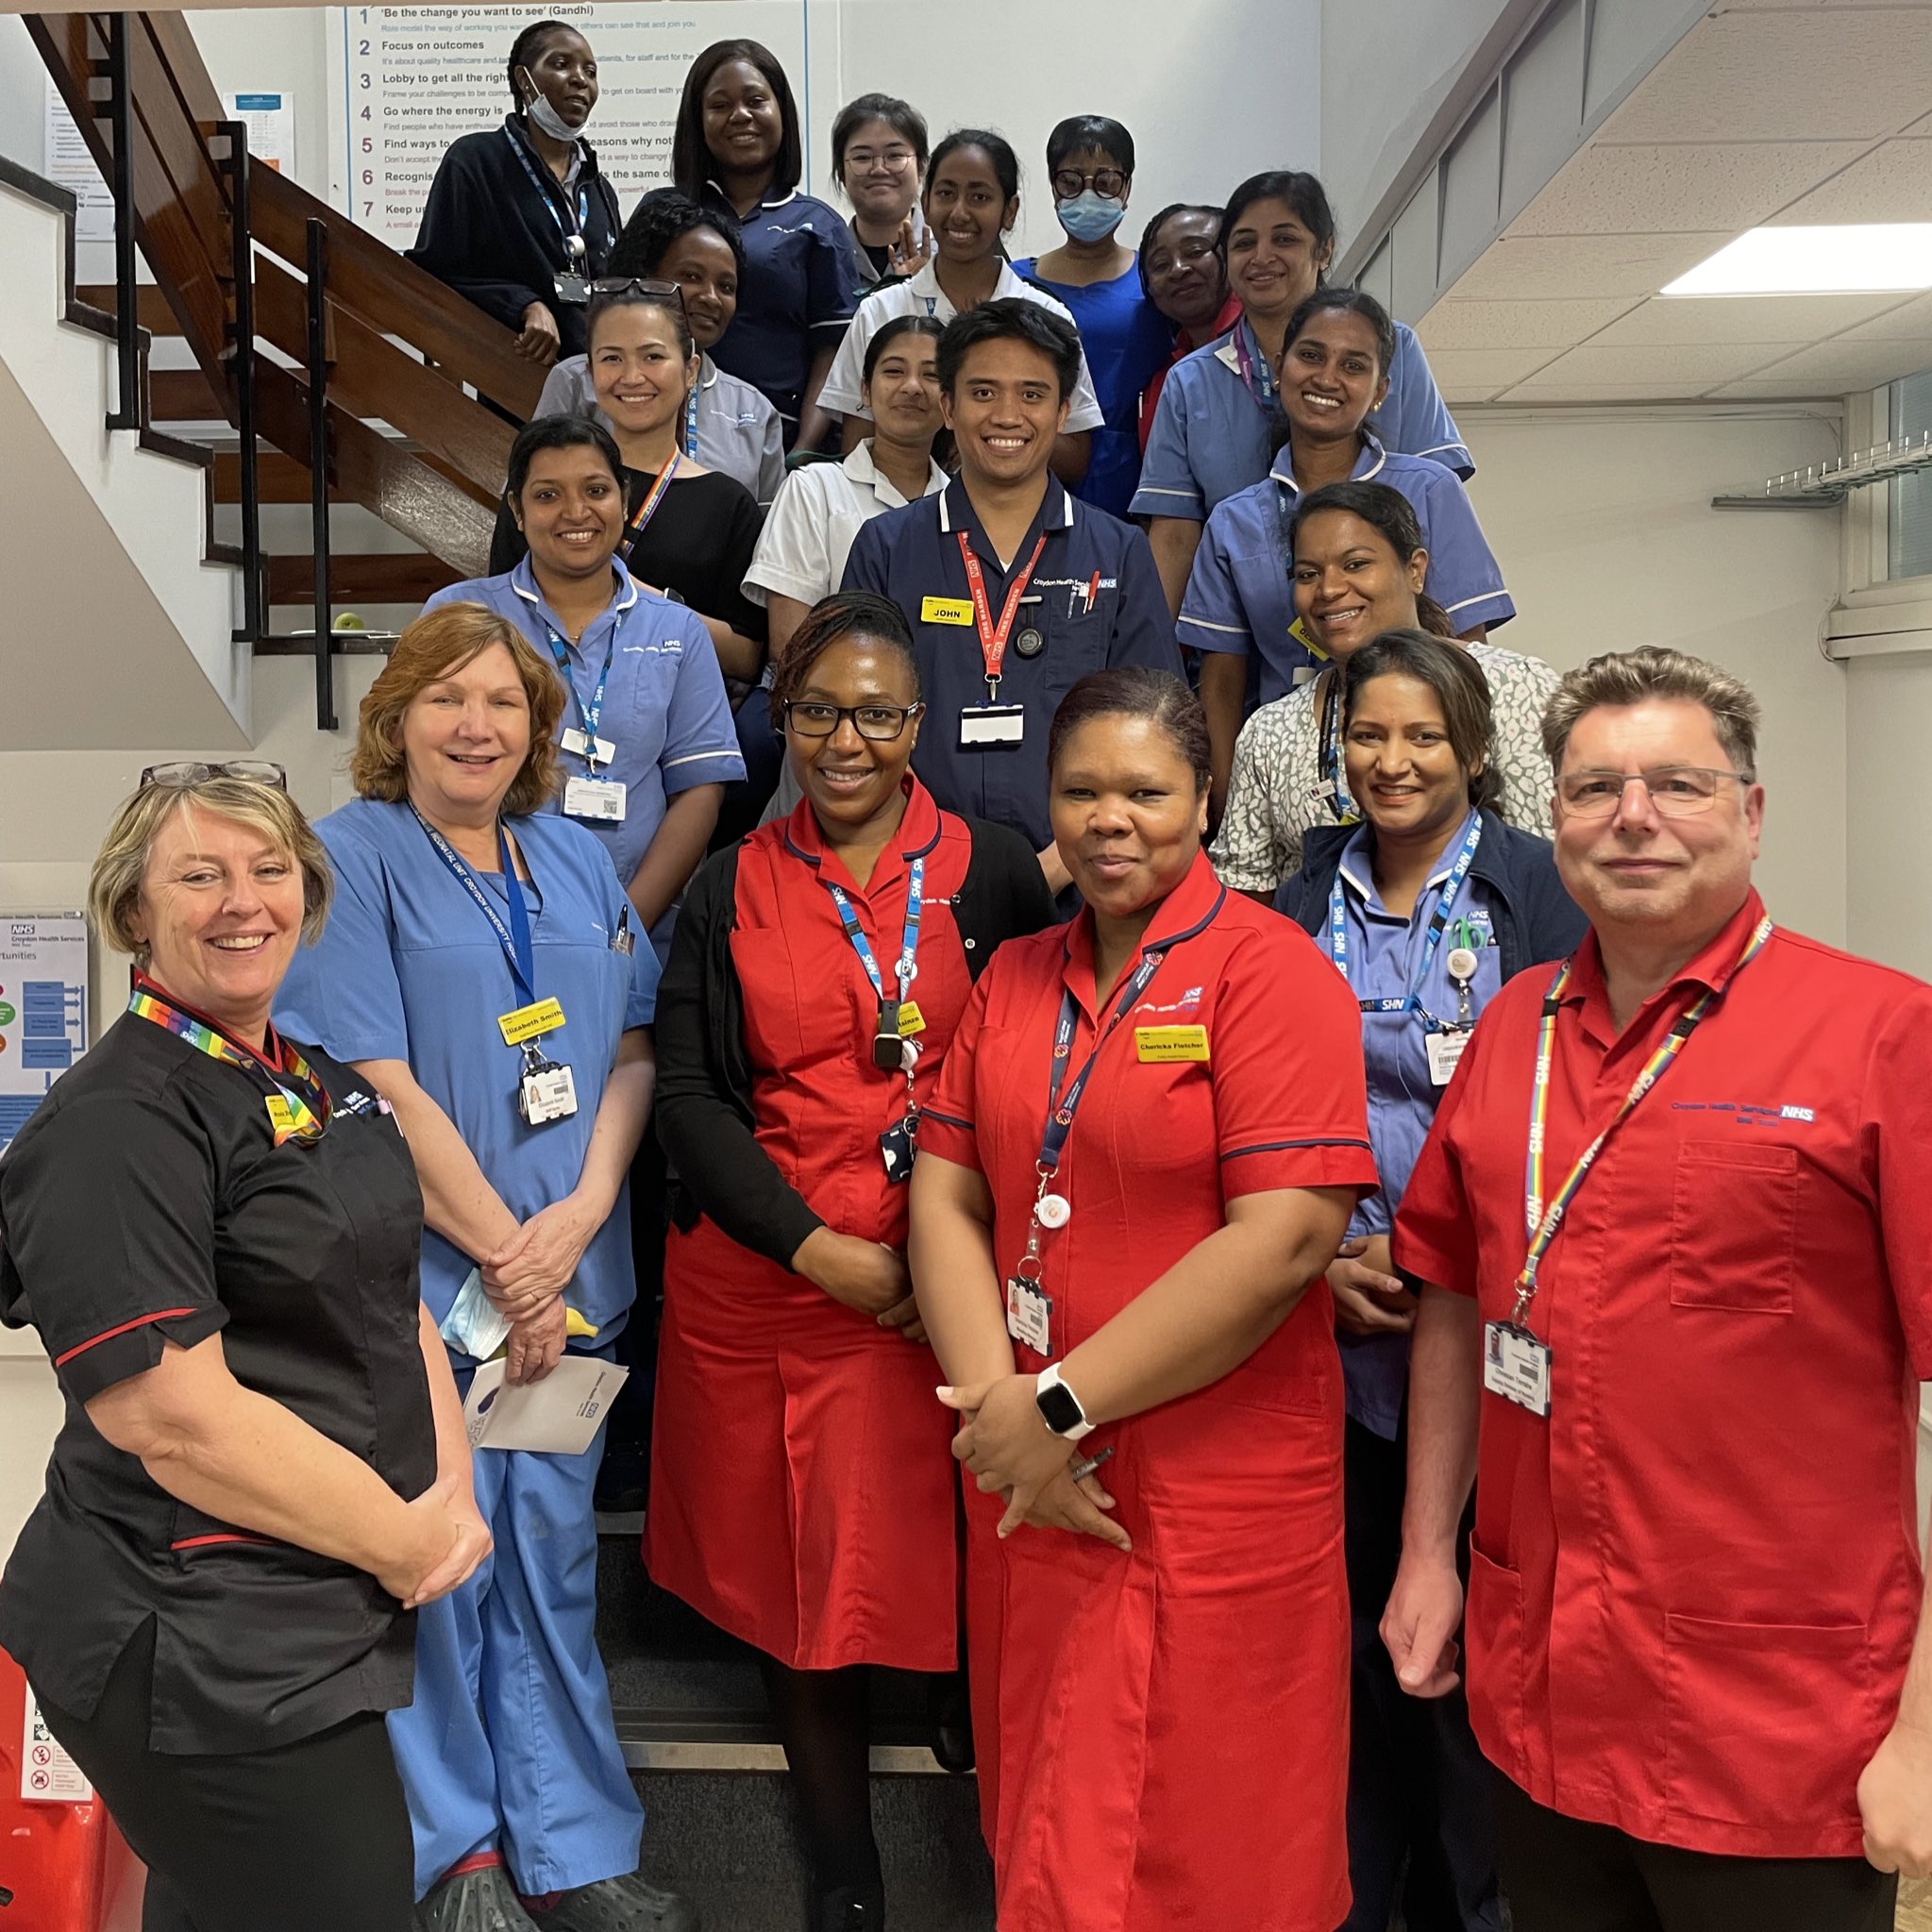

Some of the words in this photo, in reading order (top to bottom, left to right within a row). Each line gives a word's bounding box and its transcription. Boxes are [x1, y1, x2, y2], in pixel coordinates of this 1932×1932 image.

[360, 8, 367, 25] 1
[401, 8, 417, 17] the
[420, 8, 459, 19] change
[462, 8, 480, 18] you
[484, 8, 509, 16] want
[512, 8, 522, 16] to
[549, 6, 594, 17] (Gandhi)
[464, 25, 492, 33] working
[360, 40, 370, 56] 2
[381, 42, 414, 50] Focus
[433, 41, 484, 50] outcomes
[417, 57, 441, 66] quality
[361, 74, 372, 90] 3
[383, 75, 415, 85] Lobby
[418, 75, 428, 83] to
[431, 75, 448, 85] get
[451, 74, 463, 82] all
[466, 73, 482, 82] the
[427, 90, 466, 99] challenges
[611, 88, 622, 96] get
[361, 106, 372, 121] 4
[383, 107, 398, 115] Go
[401, 106, 432, 115] where
[436, 106, 452, 115] the
[455, 107, 491, 117] energy
[495, 106, 503, 114] is
[401, 124, 426, 132] people
[361, 138, 373, 153] 5
[384, 140, 407, 148] Find
[410, 141, 437, 150] ways
[440, 140, 450, 148] to
[630, 137, 652, 147] why
[406, 156, 430, 164] accept
[640, 153, 665, 161] change
[362, 170, 374, 185] 6
[385, 171, 434, 182] Recognis
[613, 170, 629, 178] the
[632, 170, 660, 178] same
[363, 201, 374, 217] 7
[385, 205, 412, 216] Keep
[967, 560, 980, 578] NHS
[1033, 578, 1056, 587] Croydon
[1098, 579, 1117, 588] NHS
[975, 588, 987, 620] WARDEN
[933, 609, 961, 618] JOHN
[999, 621, 1008, 637] FIRE
[1004, 588, 1020, 621] WARDEN
[991, 641, 1003, 661] NHS
[1466, 827, 1482, 849] NHS
[1454, 850, 1472, 877] NHS
[430, 832, 457, 865] NEONATAL
[453, 862, 468, 878] UNIT
[463, 877, 487, 907] CROYDON
[484, 905, 511, 942] UNIVERSITY
[911, 877, 922, 899] NHS
[1443, 879, 1458, 906] NHS
[832, 886, 848, 905] NHS
[1334, 905, 1344, 925] NHS
[1469, 910, 1489, 919] NHS
[11, 924, 35, 934] NHS
[1334, 932, 1346, 953] NHS
[0, 951, 37, 960] rtunities
[862, 954, 879, 975] NHS
[506, 1019, 539, 1035] Elizabeth
[540, 1010, 563, 1022] Smith
[1535, 1055, 1550, 1084] NHS
[1627, 1068, 1655, 1104] NHS
[1781, 1106, 1814, 1122] NHS
[1529, 1122, 1544, 1153] NHS
[1540, 1201, 1564, 1237] NHS
